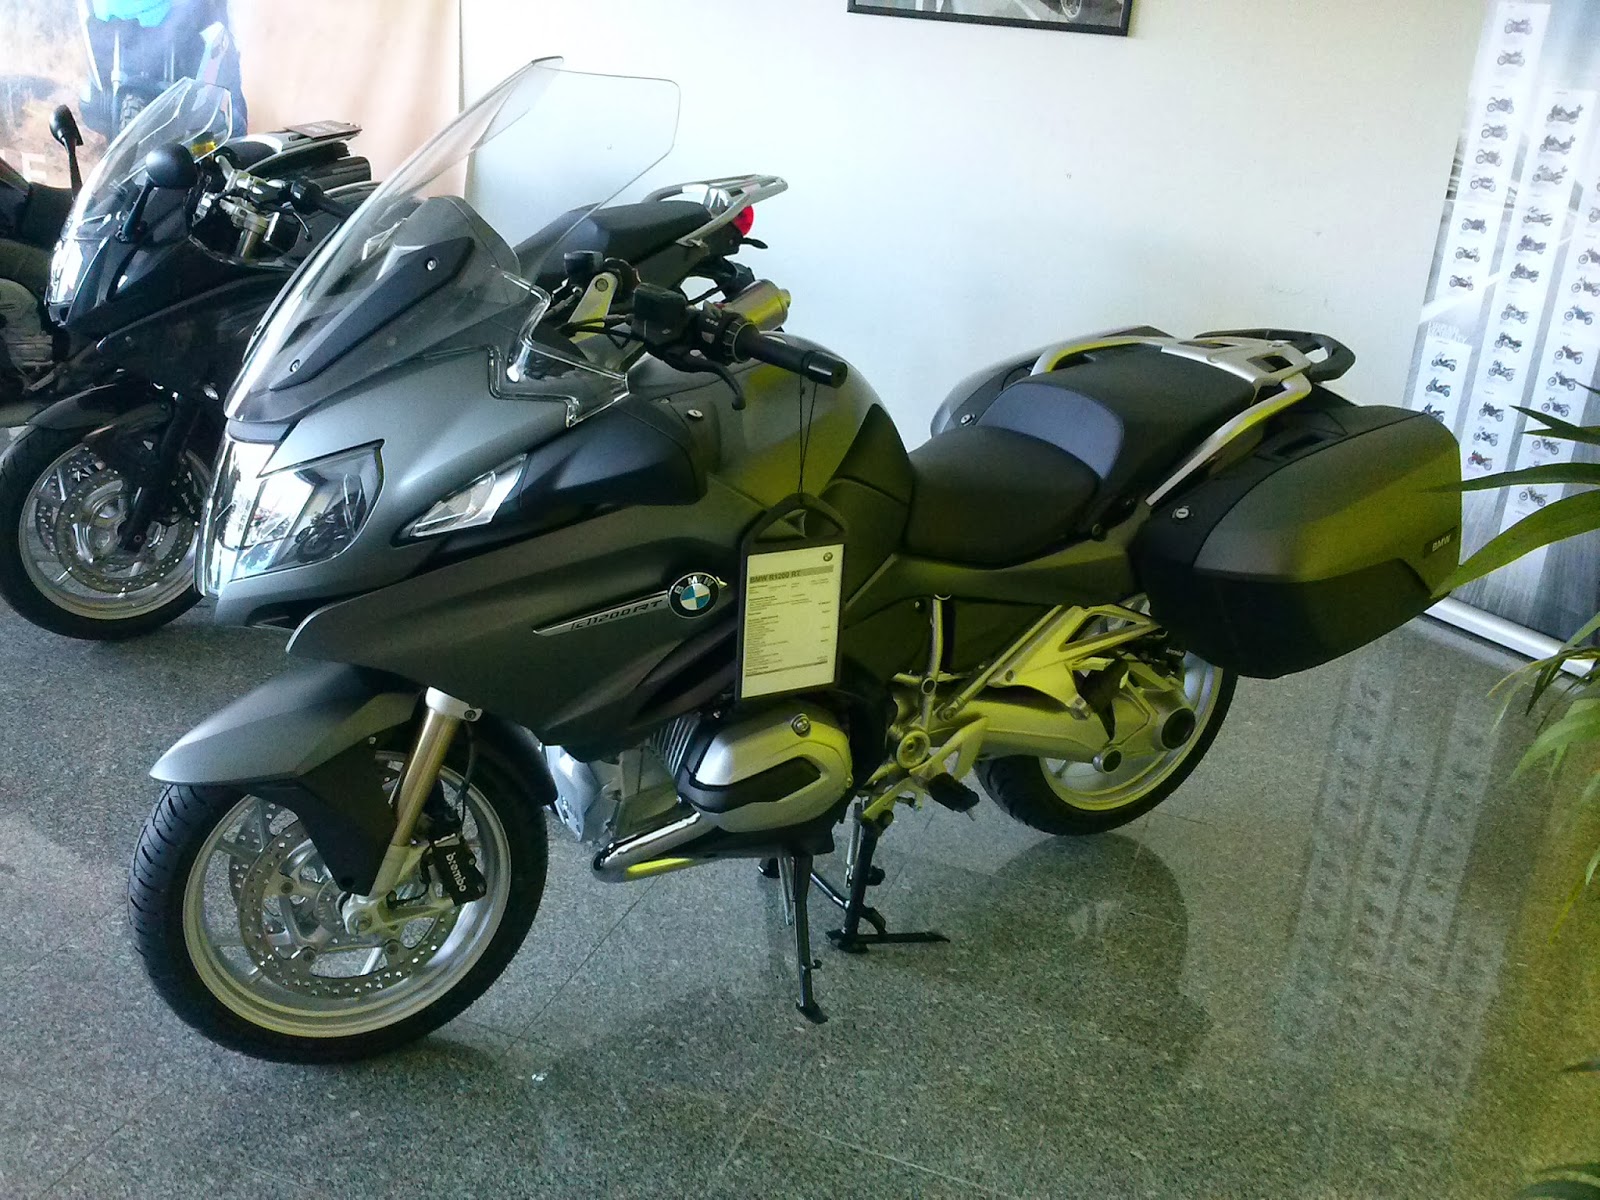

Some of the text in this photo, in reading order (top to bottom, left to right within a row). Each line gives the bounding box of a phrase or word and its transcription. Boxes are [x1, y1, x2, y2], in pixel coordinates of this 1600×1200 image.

[1432, 534, 1451, 552] BMW
[750, 569, 801, 584] BMW R1200 RT
[446, 852, 467, 892] brembo
